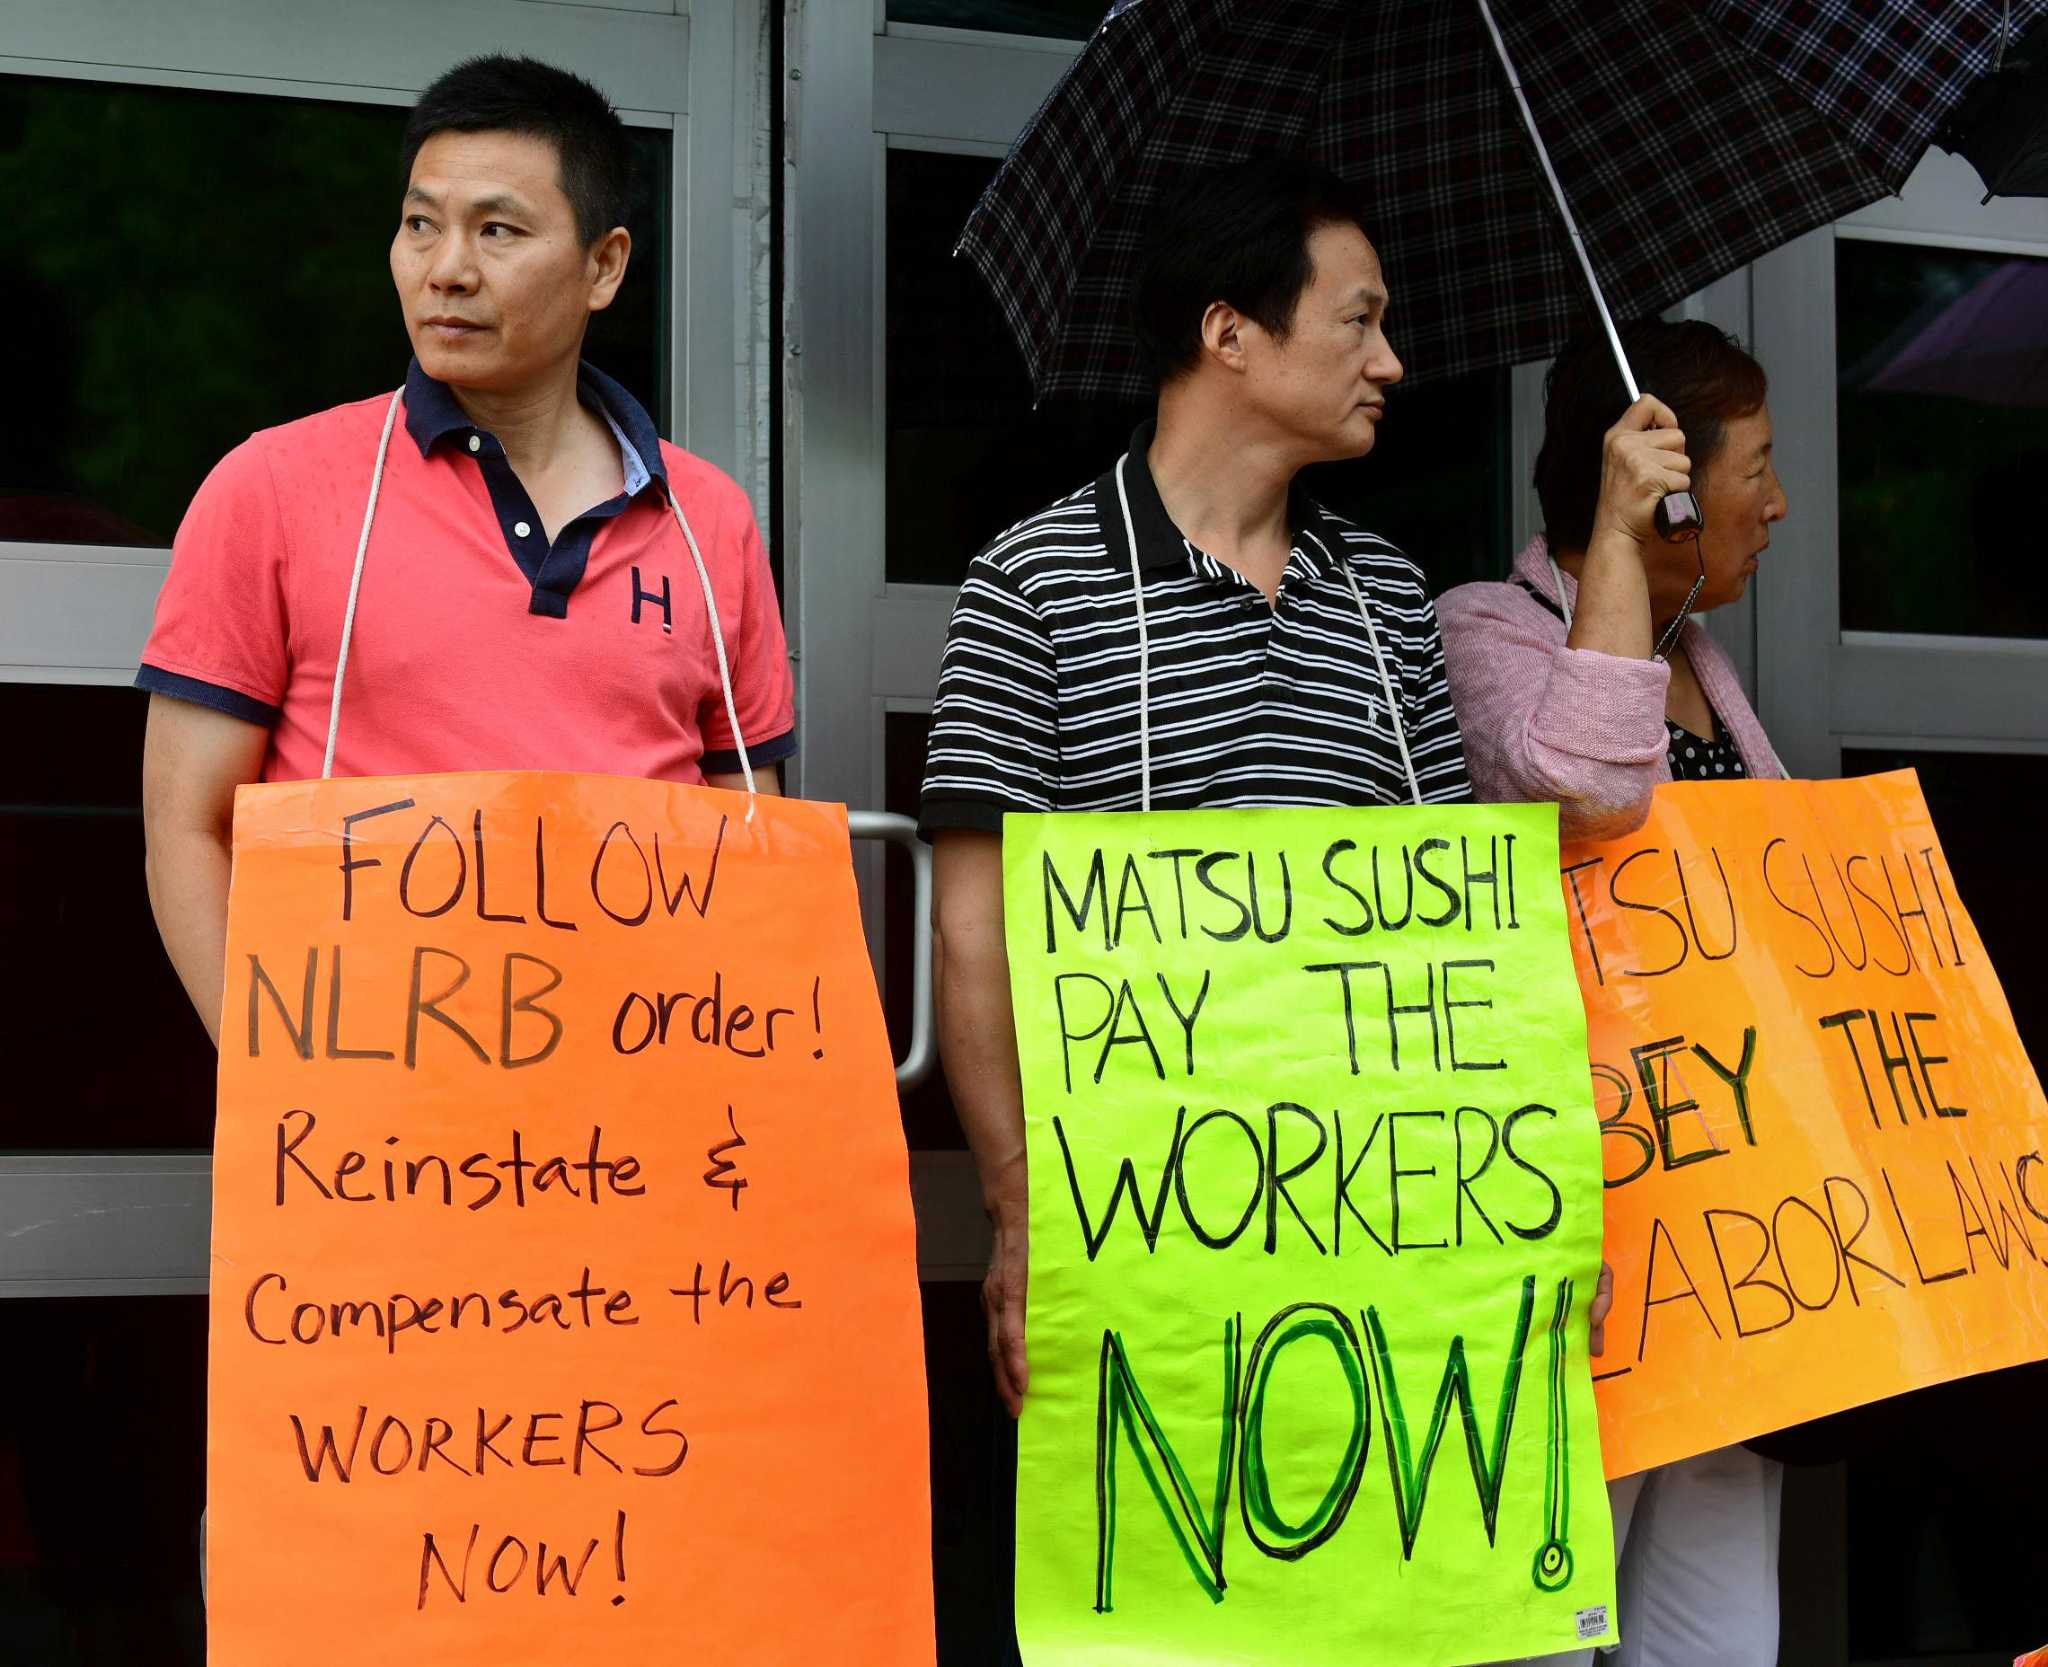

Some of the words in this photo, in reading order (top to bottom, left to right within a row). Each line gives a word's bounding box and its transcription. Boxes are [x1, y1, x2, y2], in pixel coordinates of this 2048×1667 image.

[631, 567, 671, 634] H
[338, 799, 727, 931] FOLLOW
[1043, 848, 1292, 952] MATSU
[1322, 834, 1520, 936] SUSHI
[1562, 847, 1736, 986] TSU
[1763, 838, 1966, 977] SUSHI
[246, 946, 563, 1069] NLRB
[612, 972, 825, 1060] order!
[1054, 970, 1210, 1094] PAY
[1302, 959, 1507, 1075] THE
[276, 1109, 646, 1211] Reinstate
[702, 1104, 748, 1211] &
[1590, 1025, 1757, 1188] BEY
[1819, 1008, 1966, 1129] THE
[1053, 1102, 1562, 1261] WORKERS
[245, 1267, 640, 1354] Compensate
[670, 1260, 802, 1324] the
[1592, 1176, 1905, 1380] ABOR
[1881, 1151, 2048, 1284] LAWS
[290, 1400, 688, 1483] WORKERS
[1093, 1274, 1574, 1614] NOW!
[417, 1510, 628, 1610] NOW!
